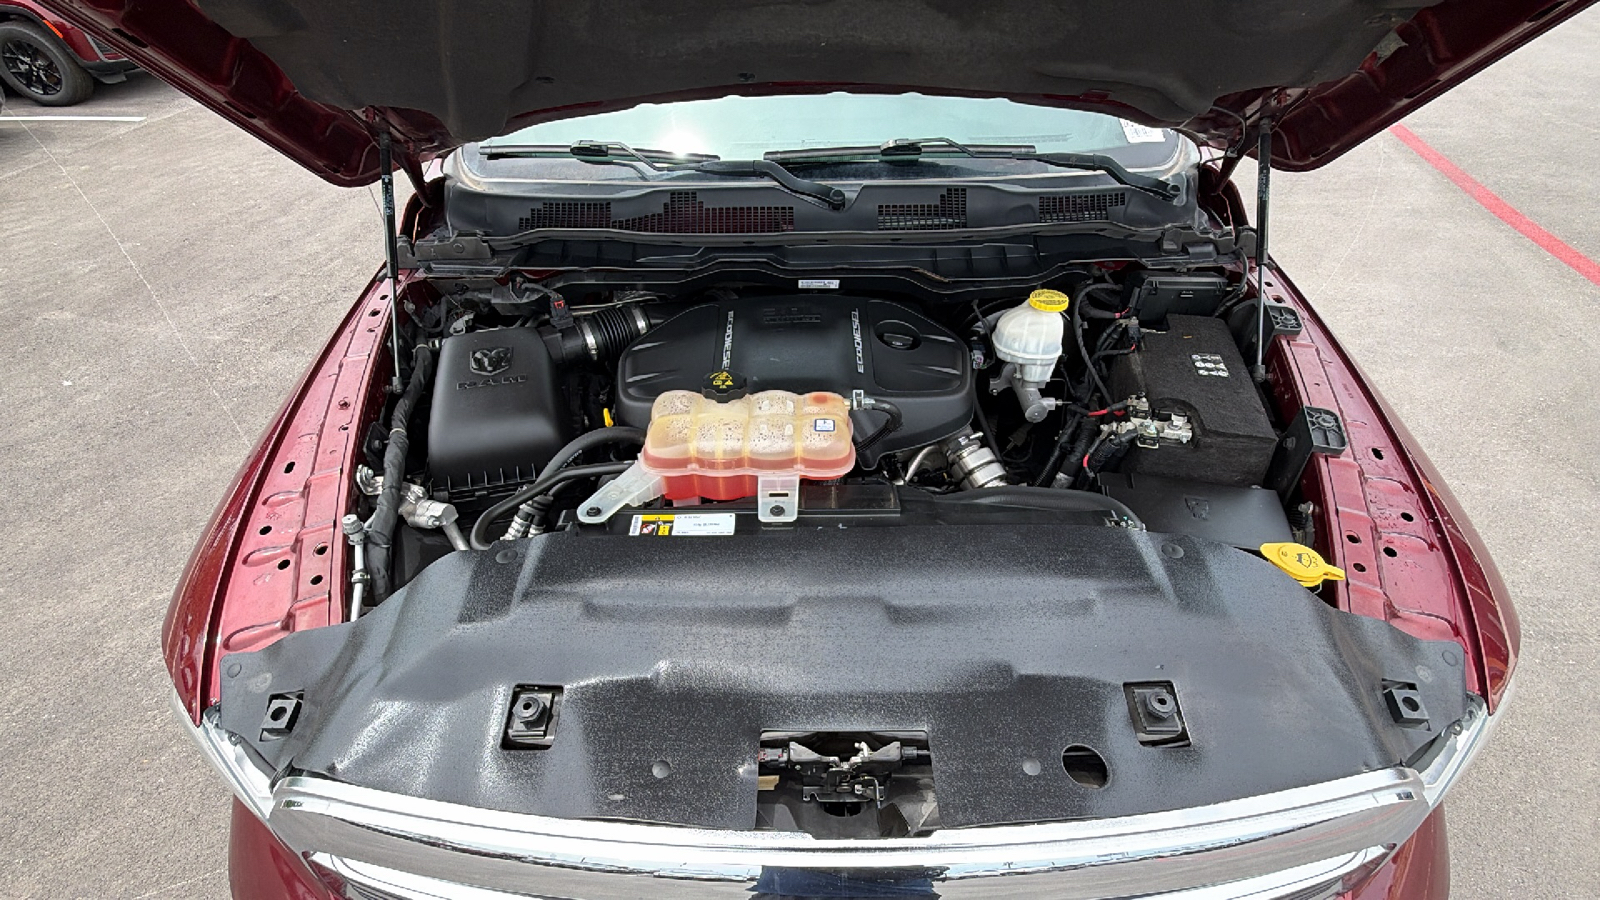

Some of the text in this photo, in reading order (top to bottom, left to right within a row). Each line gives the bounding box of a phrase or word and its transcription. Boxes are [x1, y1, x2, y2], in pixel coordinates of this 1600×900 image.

[721, 310, 734, 370] ECODIESE
[851, 307, 864, 374] ECODIESEL
[456, 374, 527, 390] RAM
